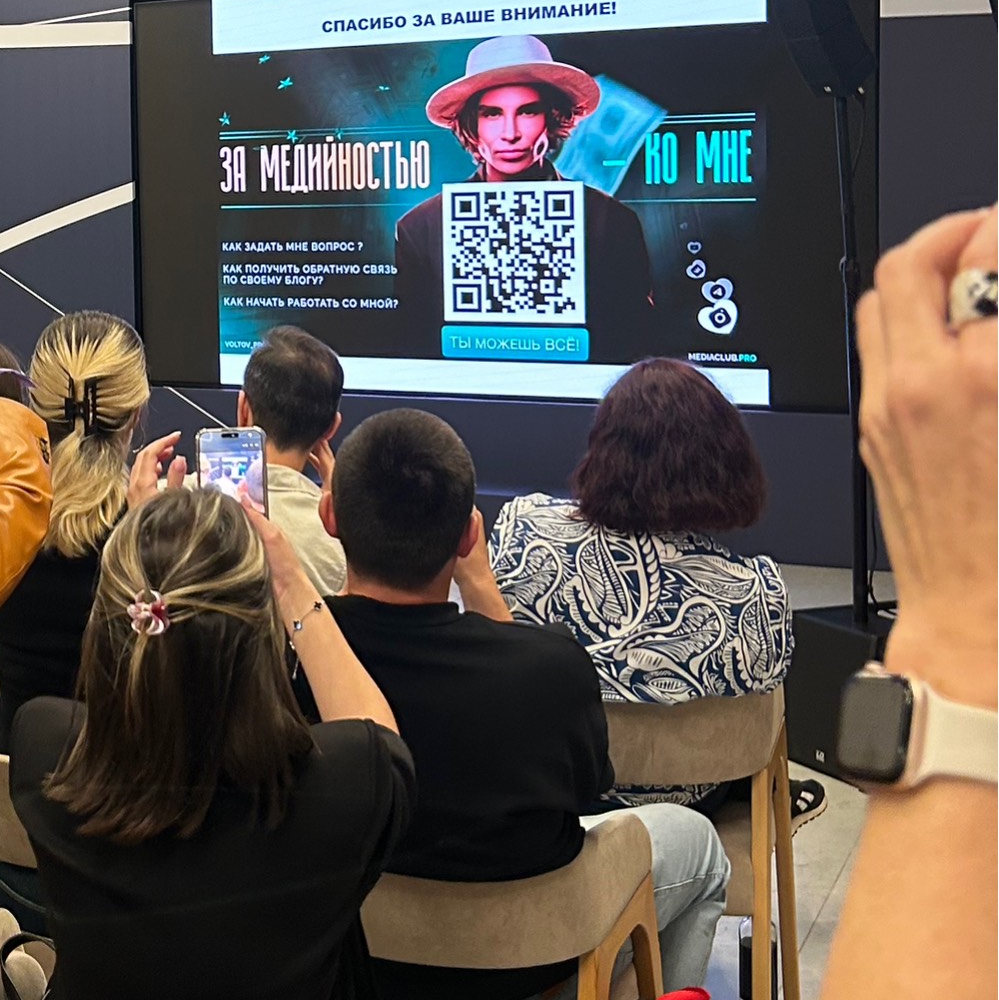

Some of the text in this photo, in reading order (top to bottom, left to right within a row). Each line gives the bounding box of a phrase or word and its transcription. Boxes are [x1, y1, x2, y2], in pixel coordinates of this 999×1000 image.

[321, 1, 617, 33] СПАСИБО ЗА ВАШЕ ВНИМАНИЕ!
[219, 145, 247, 193] ЗА
[260, 135, 431, 193] МЕДИЙНОСТЬЮ
[645, 131, 678, 184] КО
[696, 129, 752, 184] МНЕ
[222, 242, 242, 251] КАК
[244, 242, 284, 253] ЗАДАТЬ
[286, 242, 308, 251] МНЕ
[311, 242, 355, 251] ВОПРОС
[222, 264, 398, 275] КАК ПОЛУЧИТЬ ОБРАТНУЮ СВЯЗЬ
[223, 275, 324, 285] ПО СВОЕМУ БЛОГУ?
[224, 297, 399, 309] КАК НАЧАТЬ РАБОТАТЬ СО МНОЙ?
[449, 335, 580, 352] ТЫ МОЖЕШЬ ВСЁ!
[688, 352, 758, 363] MEDIACLUB.PRO
